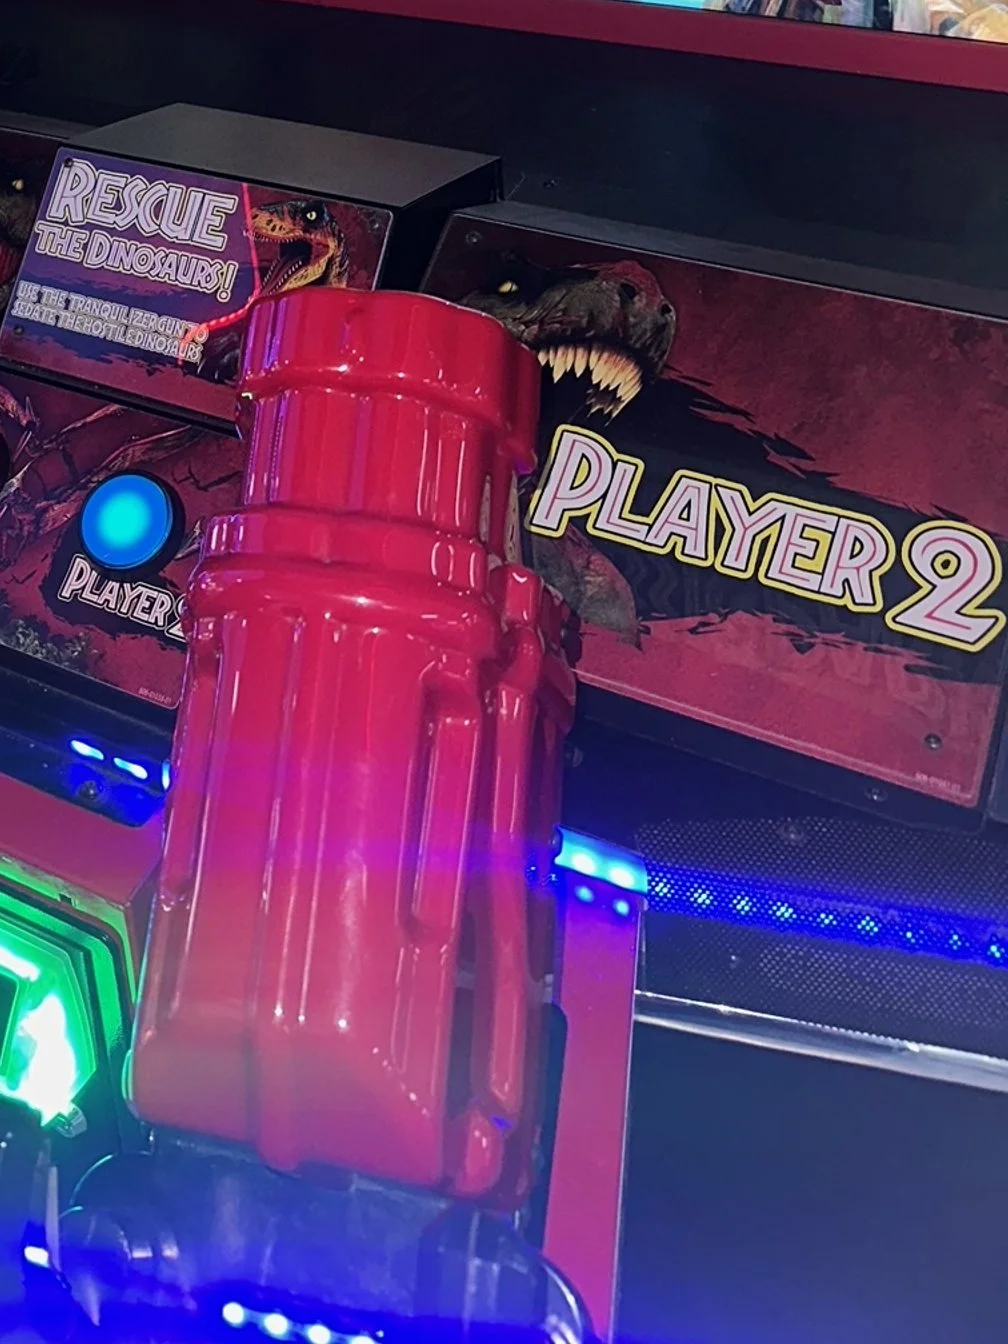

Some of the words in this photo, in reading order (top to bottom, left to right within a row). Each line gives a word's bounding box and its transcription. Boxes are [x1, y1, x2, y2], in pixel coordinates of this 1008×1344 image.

[46, 158, 239, 251] RESCUE
[34, 219, 90, 261] THE
[83, 230, 239, 302] DINOSAURS!
[11, 299, 56, 325] SEDATE
[56, 311, 80, 331] THE
[81, 314, 134, 346] HOSTILE
[134, 330, 205, 363] DINOSAURS
[17, 280, 41, 302] USE
[42, 285, 67, 306] THE
[68, 292, 158, 331] TRANQUILIZER
[157, 314, 184, 338] GUN
[184, 321, 210, 344] TO
[527, 424, 895, 612] PLAYER
[884, 519, 1006, 653] 2
[58, 554, 176, 631] PLAYER
